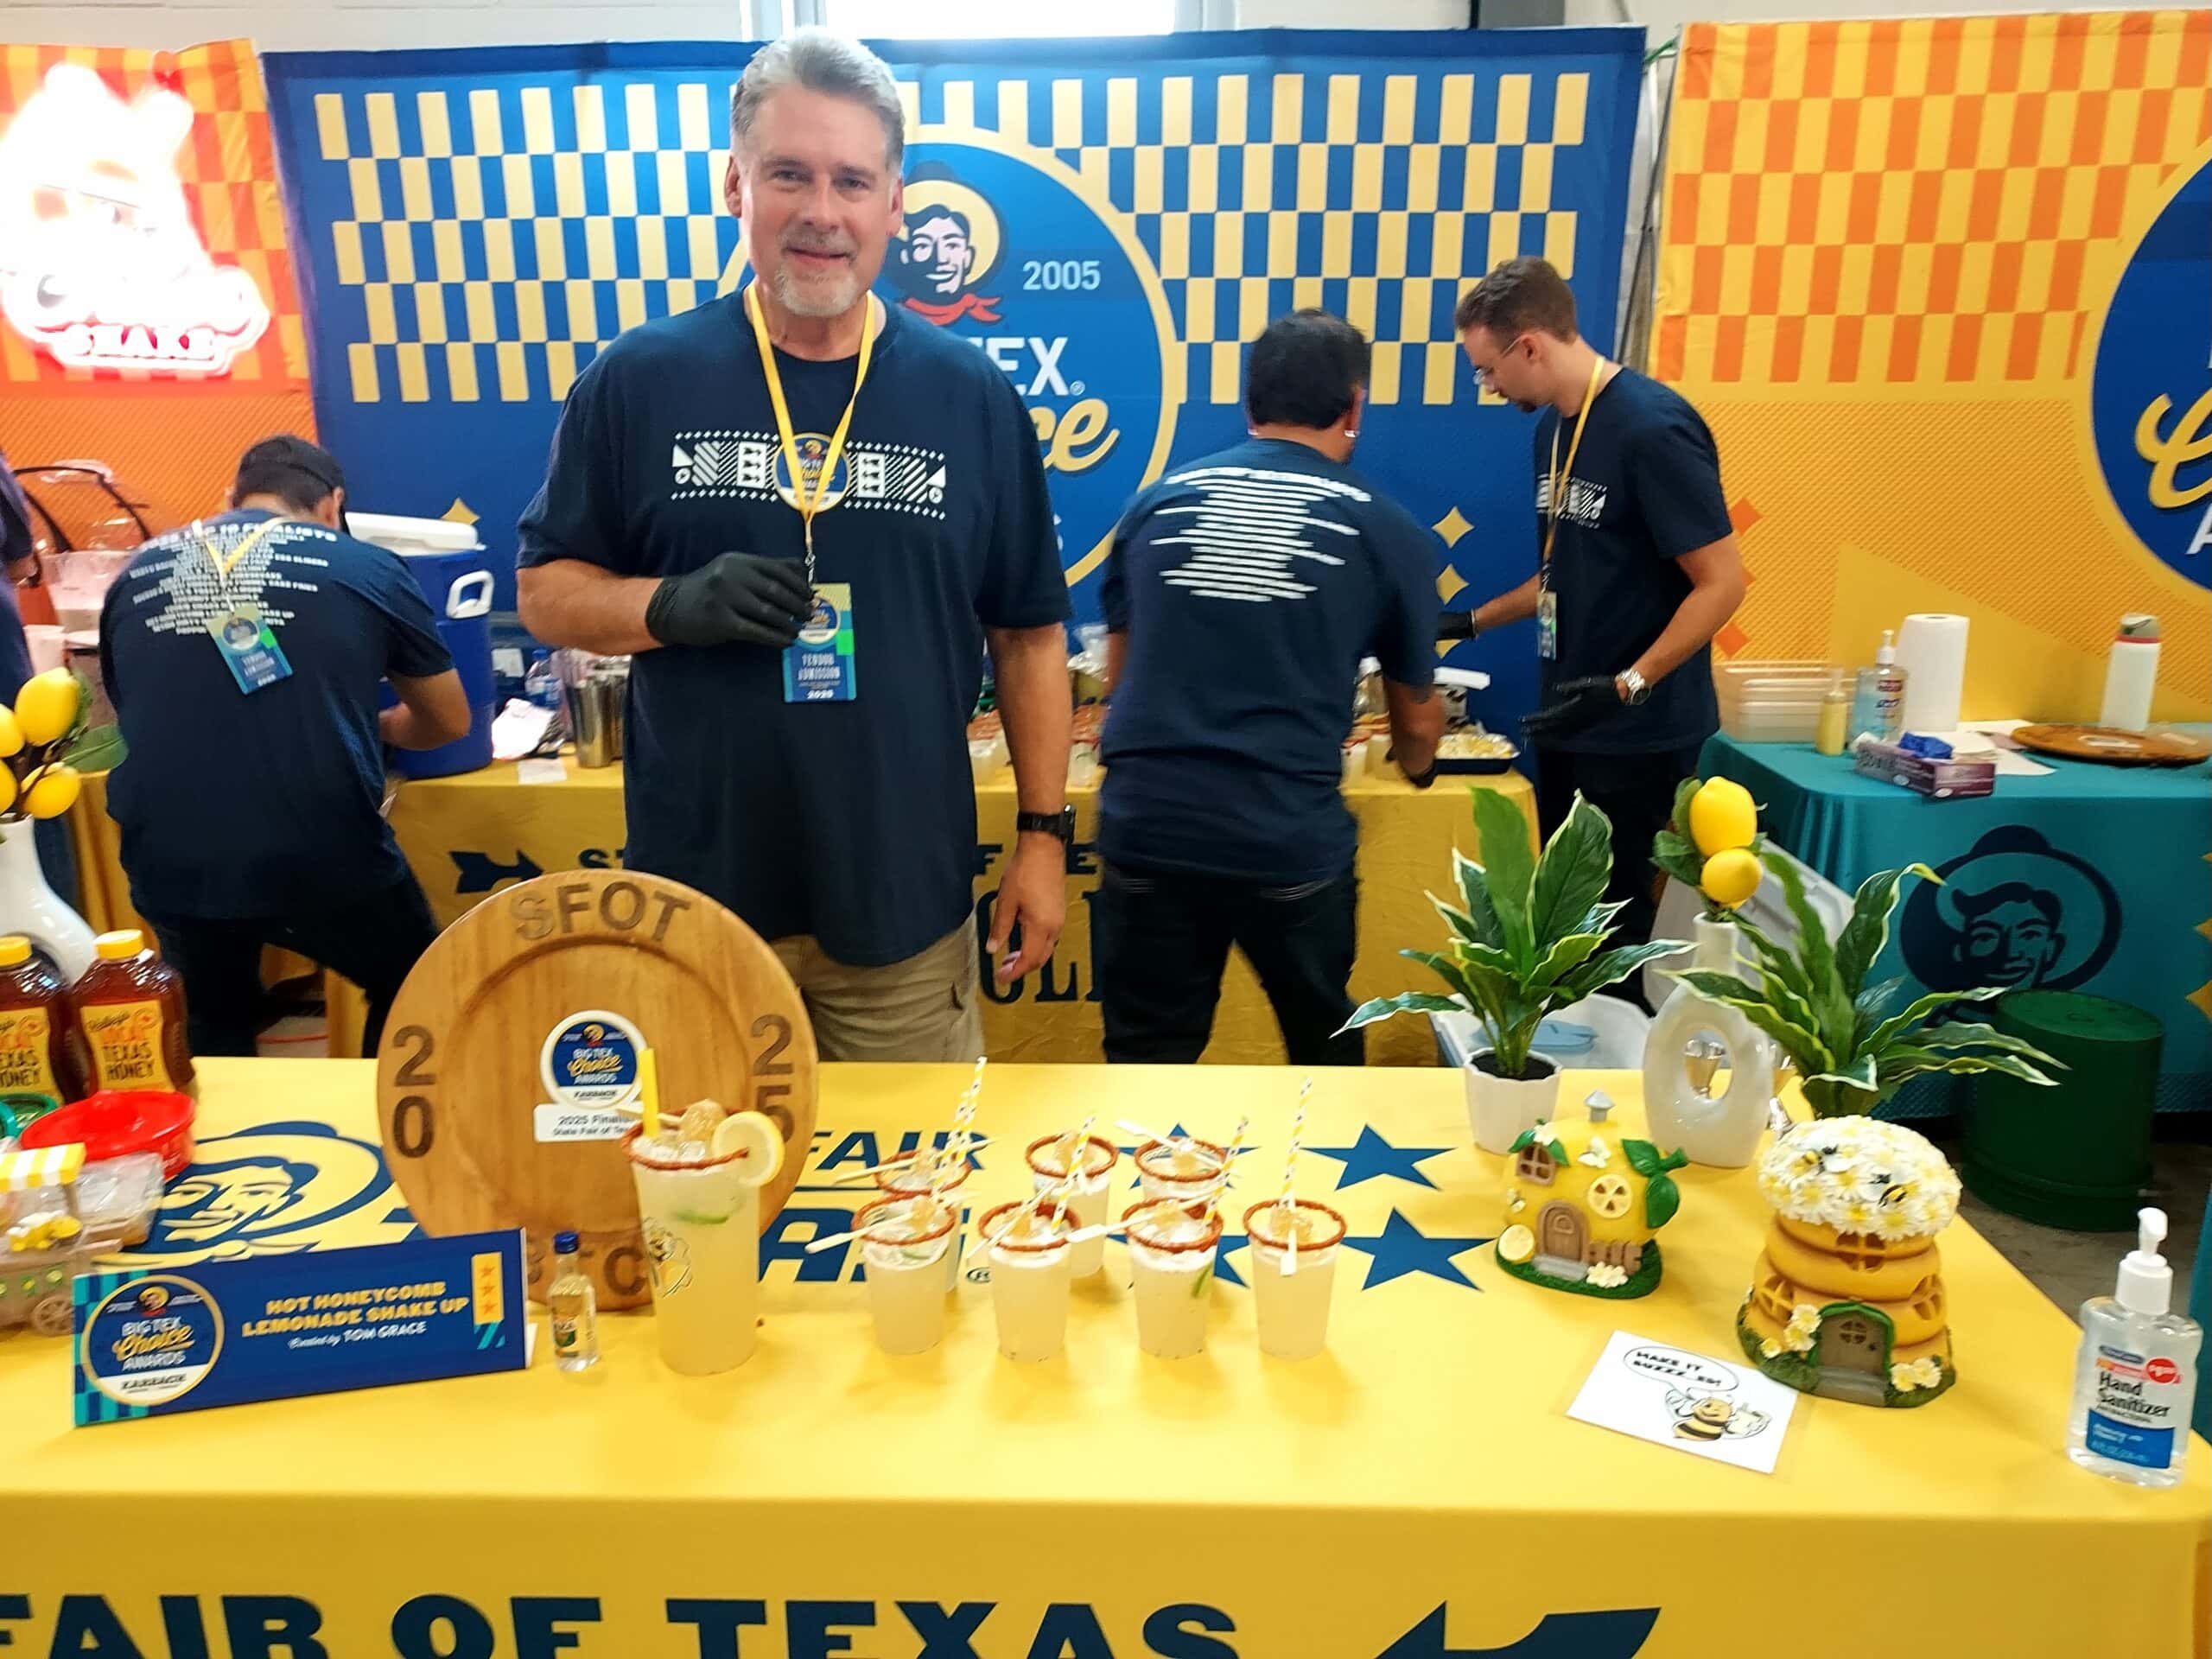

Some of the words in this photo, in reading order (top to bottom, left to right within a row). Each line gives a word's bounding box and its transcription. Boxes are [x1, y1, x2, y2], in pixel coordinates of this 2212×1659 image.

[1022, 260, 1101, 290] 2005
[510, 881, 690, 944] SFOT
[103, 1041, 153, 1063] TEXAS
[567, 1055, 623, 1077] Choice
[558, 1114, 588, 1125] 2025
[266, 1296, 312, 1315] HOT
[314, 1281, 447, 1307] HONEYCOMB
[121, 1320, 150, 1337] BIG
[151, 1316, 182, 1332] TEX
[242, 1311, 362, 1338] LEMONADE
[365, 1300, 437, 1323] SHAKE
[440, 1297, 470, 1313] UP
[111, 1325, 195, 1362] Choice
[343, 1328, 375, 1342] TOM
[377, 1321, 428, 1339] GRACE
[122, 1351, 186, 1371] AWARDS
[1637, 1351, 1680, 1366] MAKE
[1686, 1363, 1703, 1371] IT
[2099, 1370, 2144, 1396] Hand
[2097, 1386, 2171, 1417] Sanitizer
[391, 1593, 602, 1659] OF
[665, 1599, 1241, 1659] TEXAS
